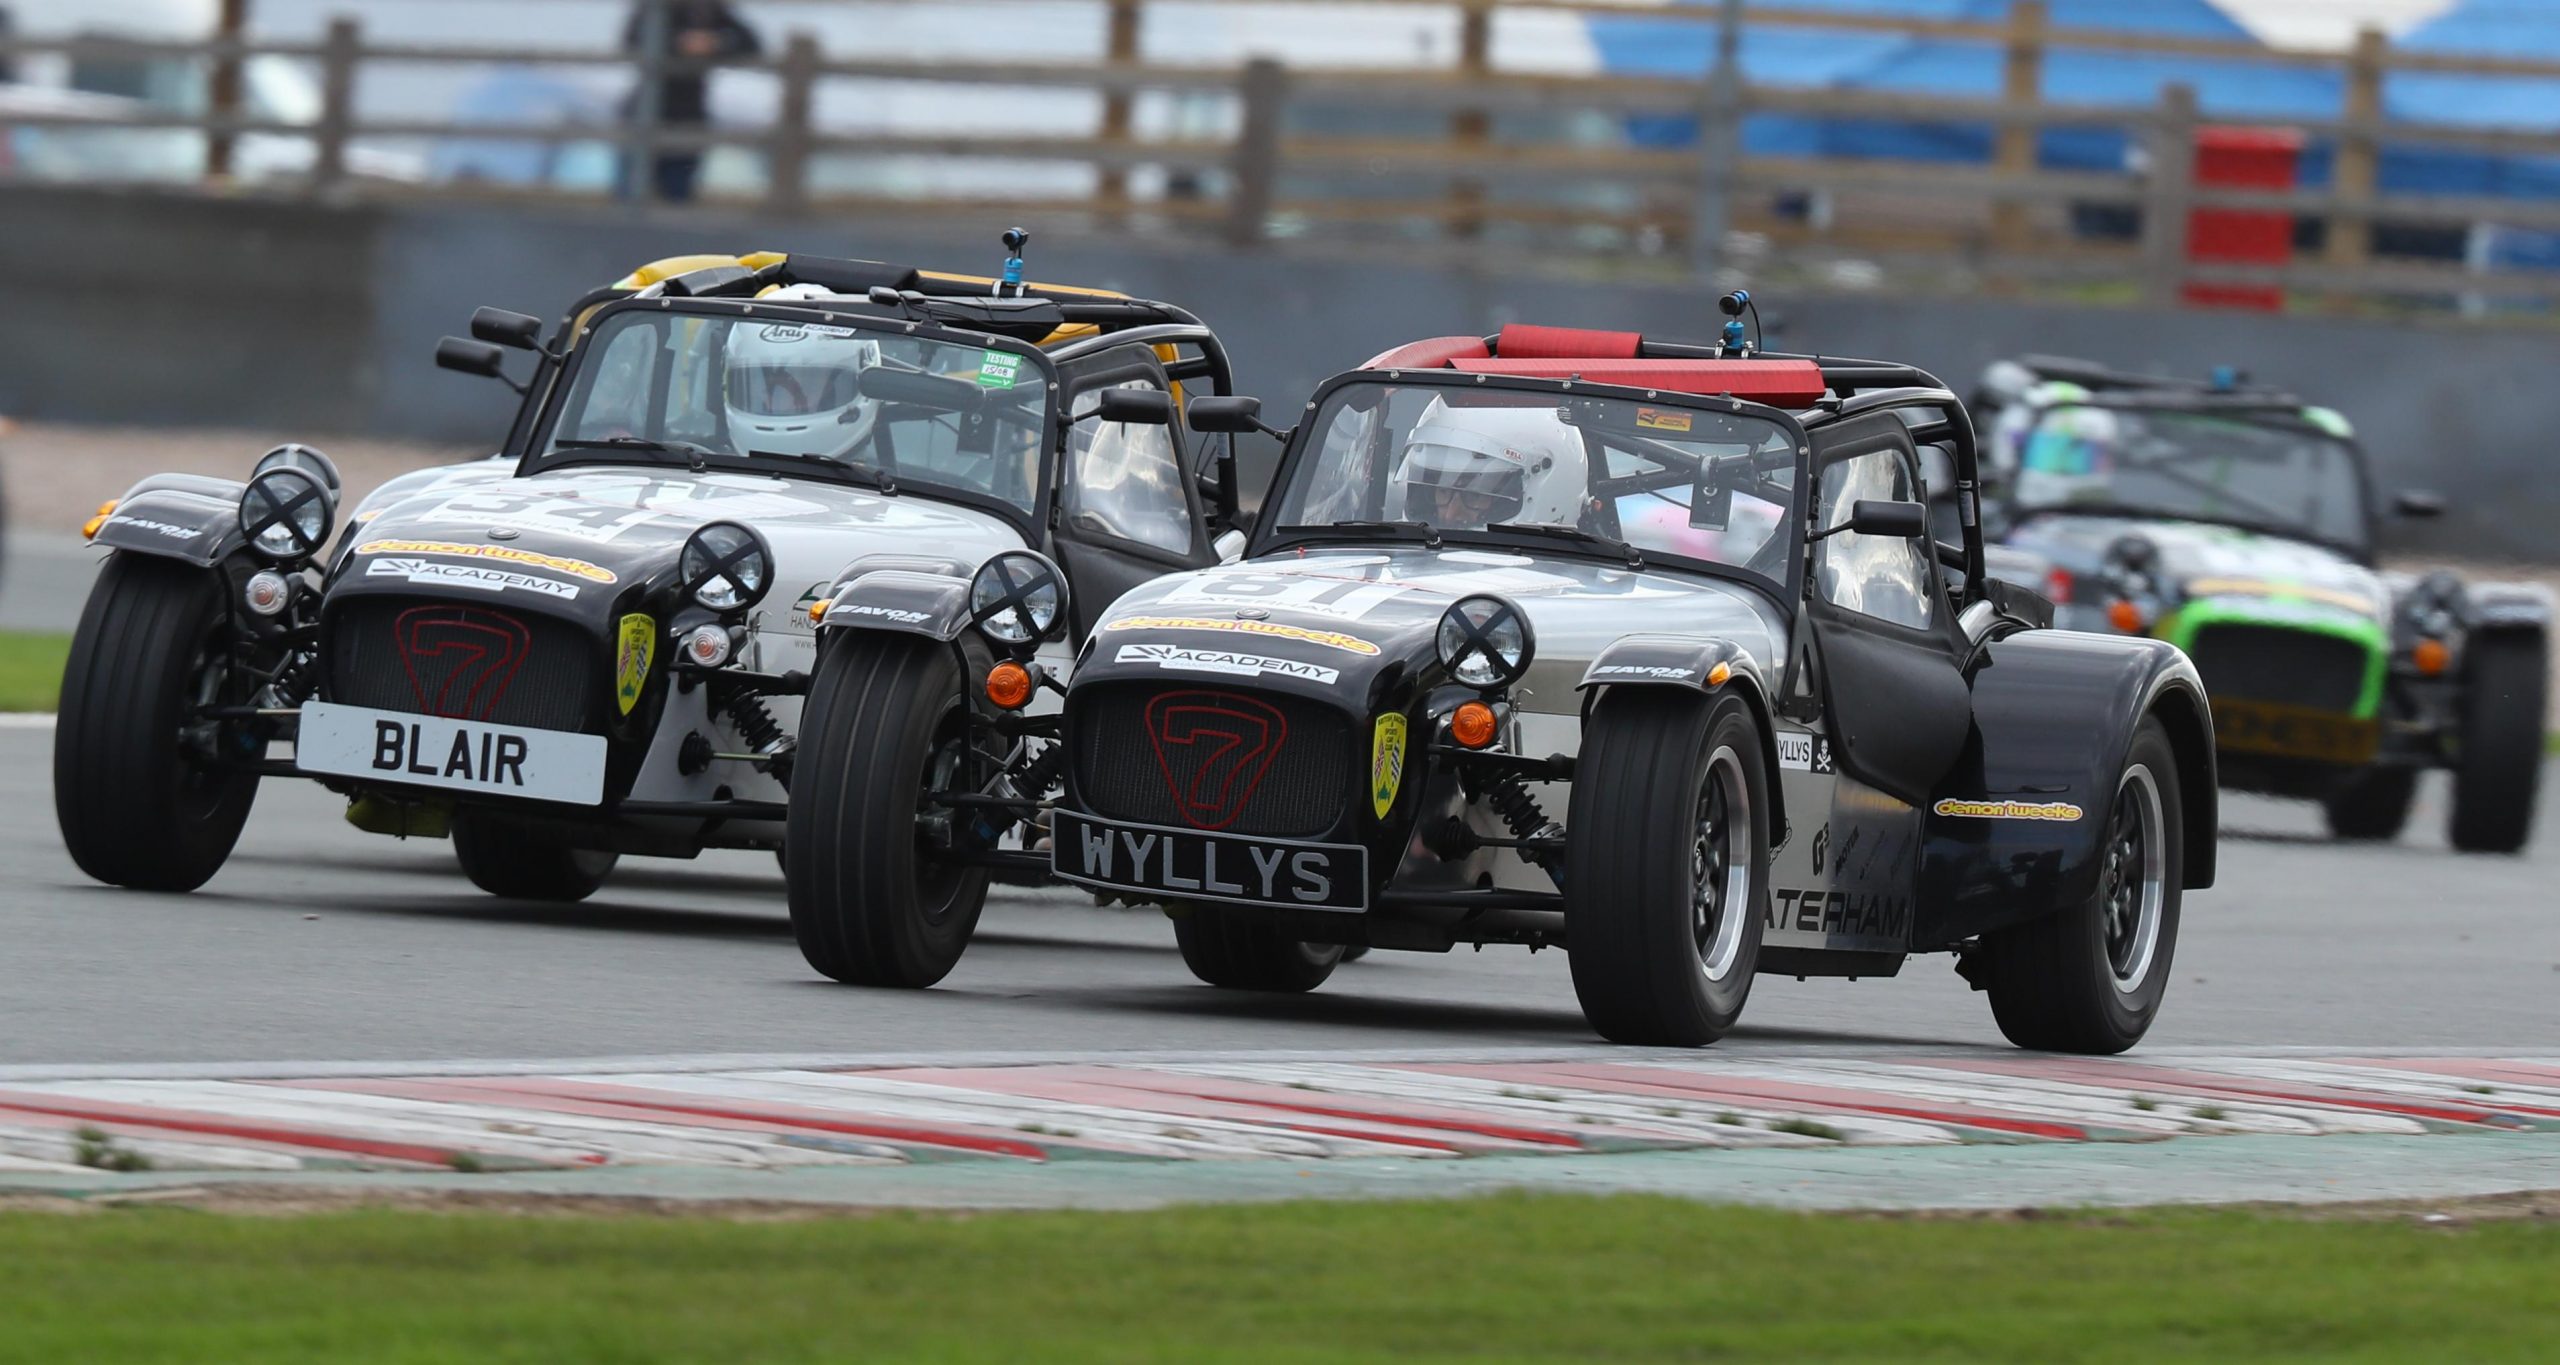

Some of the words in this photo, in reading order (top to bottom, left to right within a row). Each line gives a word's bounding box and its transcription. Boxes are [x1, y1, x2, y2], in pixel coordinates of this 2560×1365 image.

[762, 323, 802, 338] Arai
[804, 324, 853, 335] ACADEMY
[986, 352, 1019, 367] TESTING
[1505, 449, 1521, 460] BELL
[446, 493, 640, 529] 34
[126, 519, 202, 538] AVON
[434, 514, 600, 537] CATERHAM
[360, 541, 479, 554] demon
[482, 545, 615, 582] tweeks
[420, 565, 573, 593] ACADEMY
[850, 606, 932, 620] AVON
[1173, 595, 1350, 617] CATERHAM
[1110, 617, 1233, 630] demon
[1237, 620, 1378, 654] tweeks
[411, 620, 513, 719] 7
[1171, 649, 1335, 679] ACADEMY
[1614, 666, 1696, 677] AVON
[372, 718, 529, 787] BLAIR
[1162, 706, 1268, 812] 7
[1778, 740, 1810, 763] YLLYS
[1937, 801, 2004, 815] demon
[2006, 803, 2081, 819] tweeks
[1081, 823, 1331, 902] WYLLYS
[1765, 888, 1907, 938] ATERHAM
